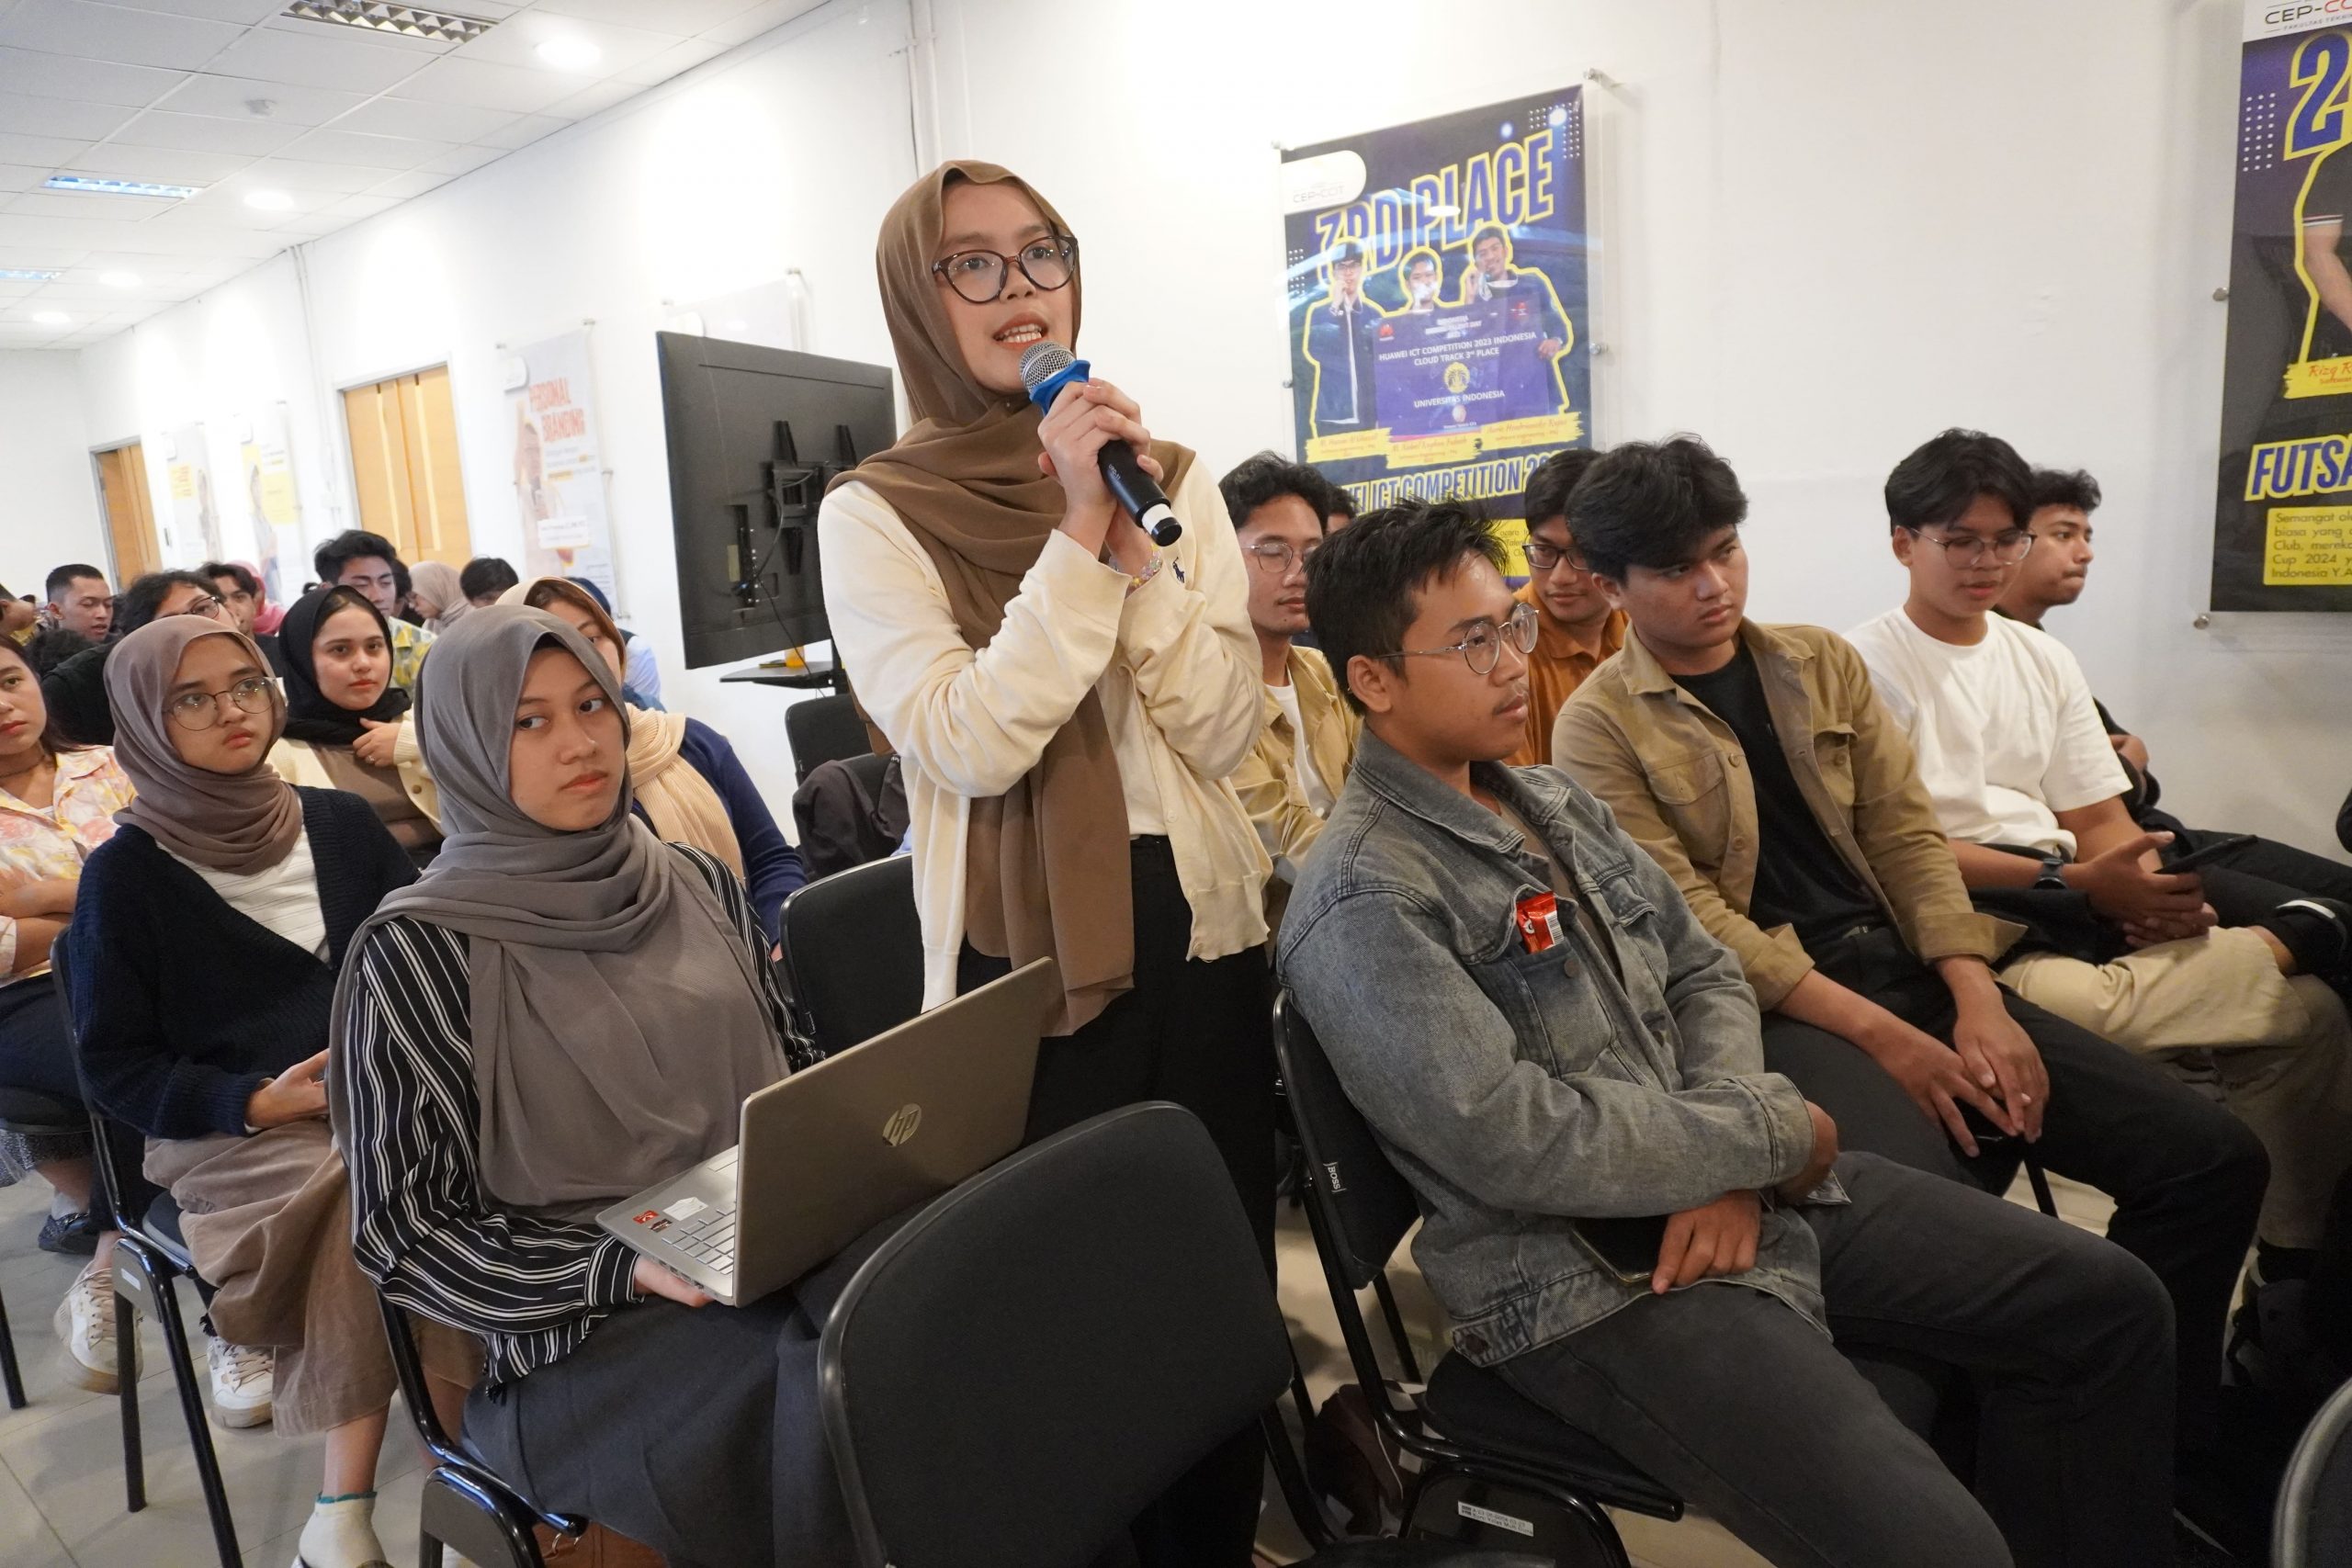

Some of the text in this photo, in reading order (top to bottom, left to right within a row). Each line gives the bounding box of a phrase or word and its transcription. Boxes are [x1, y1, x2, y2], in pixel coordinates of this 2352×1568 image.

[1411, 129, 1555, 251] PLACE
[1379, 331, 1537, 362] HUAWEI ICT COMPETITION 2023 INDONESIA
[1414, 355, 1440, 367] CLOUD
[1442, 352, 1464, 363] TRACK
[1476, 346, 1500, 357] PLACE
[1414, 389, 1506, 408] UNIVERSITAS INDONESIA
[1370, 477, 1400, 512] ICT
[1401, 456, 1523, 507] COMPETITION
[2276, 513, 2335, 525] Semangat
[2275, 526, 2343, 538] biasa yang
[2273, 554, 2297, 567] Cup
[2305, 553, 2337, 565] 2024
[2271, 566, 2328, 578] Indonesia
[1327, 1166, 1341, 1190] BOSS
